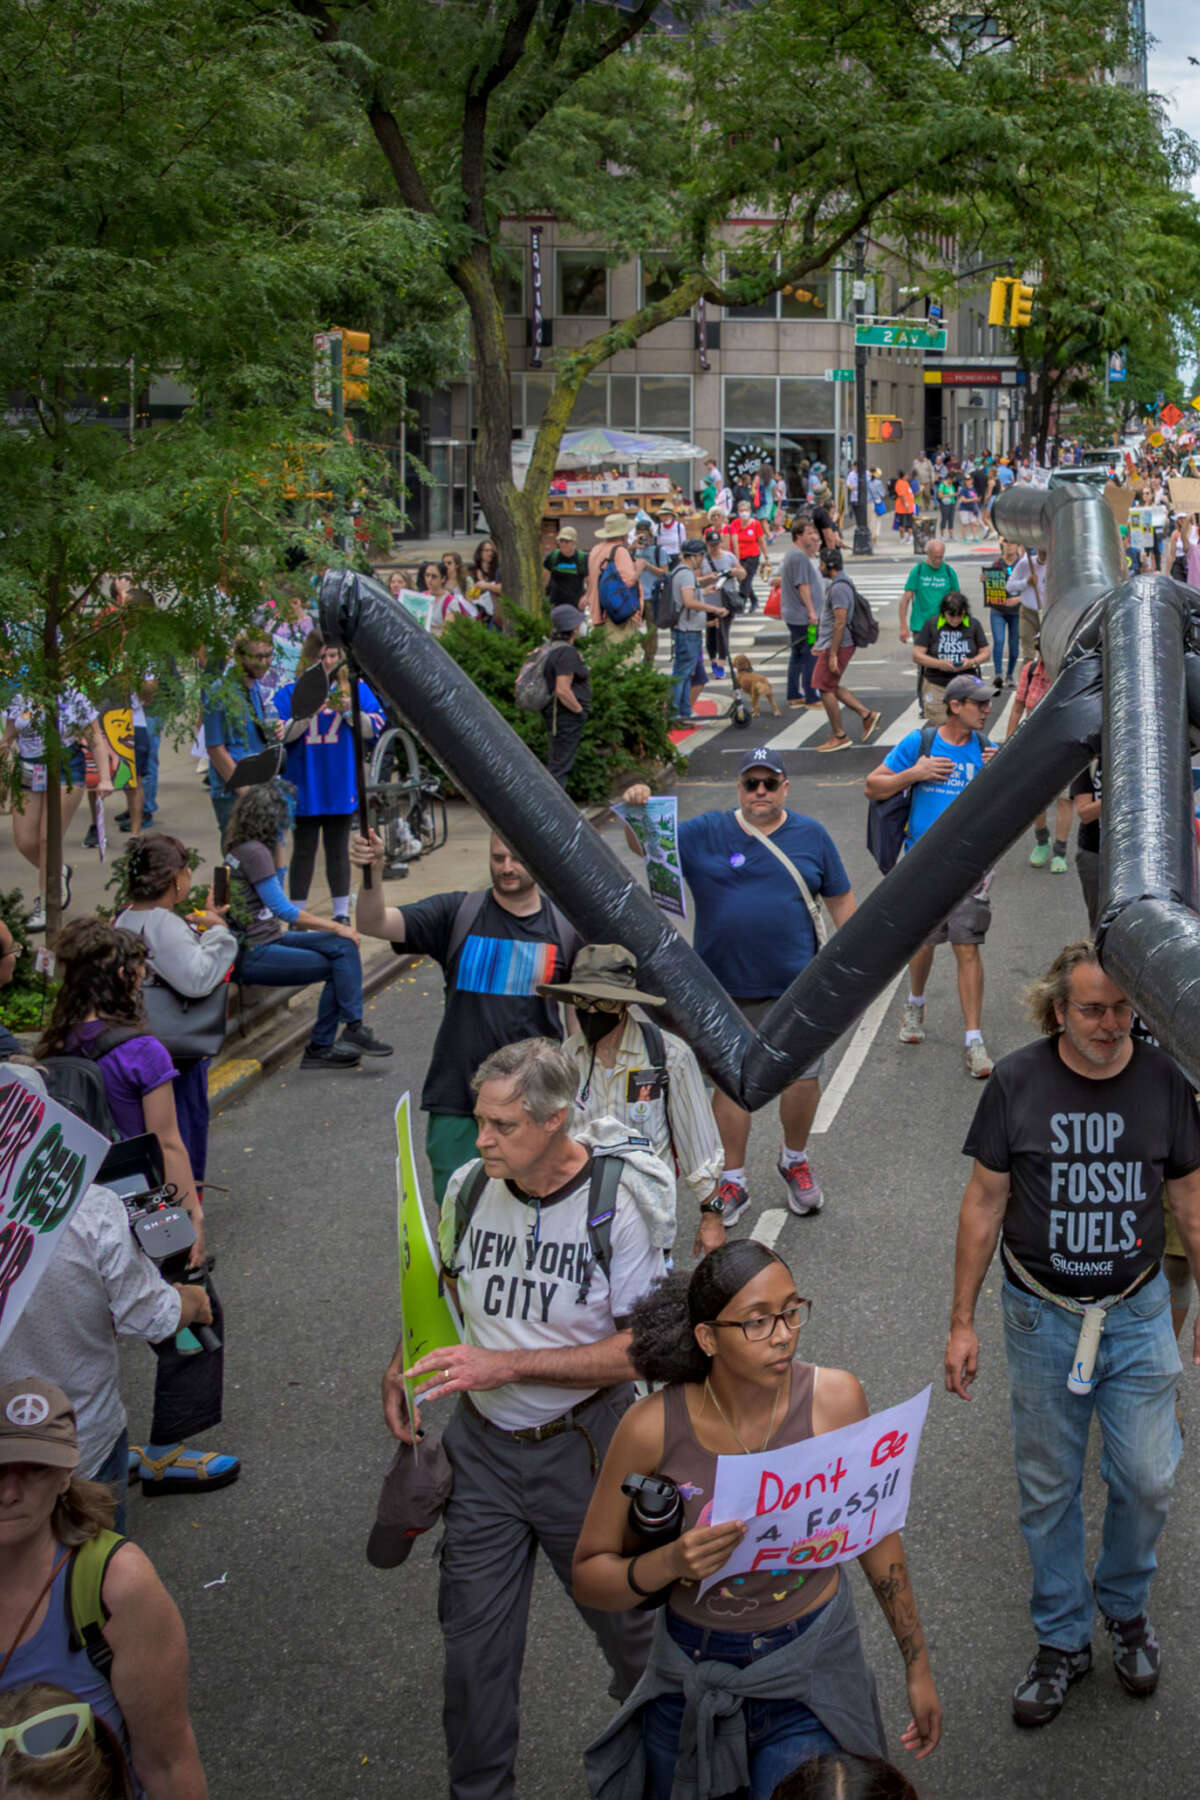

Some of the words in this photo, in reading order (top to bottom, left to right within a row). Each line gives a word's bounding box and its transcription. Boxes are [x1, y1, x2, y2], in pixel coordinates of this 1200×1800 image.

[883, 330, 892, 343] 2
[938, 641, 971, 653] FOSSIL
[1050, 1112, 1125, 1154] STOP
[1050, 1161, 1147, 1204] FOSSIL
[143, 1213, 180, 1231] SHAPE
[1048, 1208, 1143, 1253] FUELS.
[470, 1226, 517, 1270] NEW
[484, 1274, 558, 1323] CITY
[755, 1456, 848, 1516] Don't
[869, 1430, 909, 1468] Be
[806, 1468, 901, 1537] Fossil
